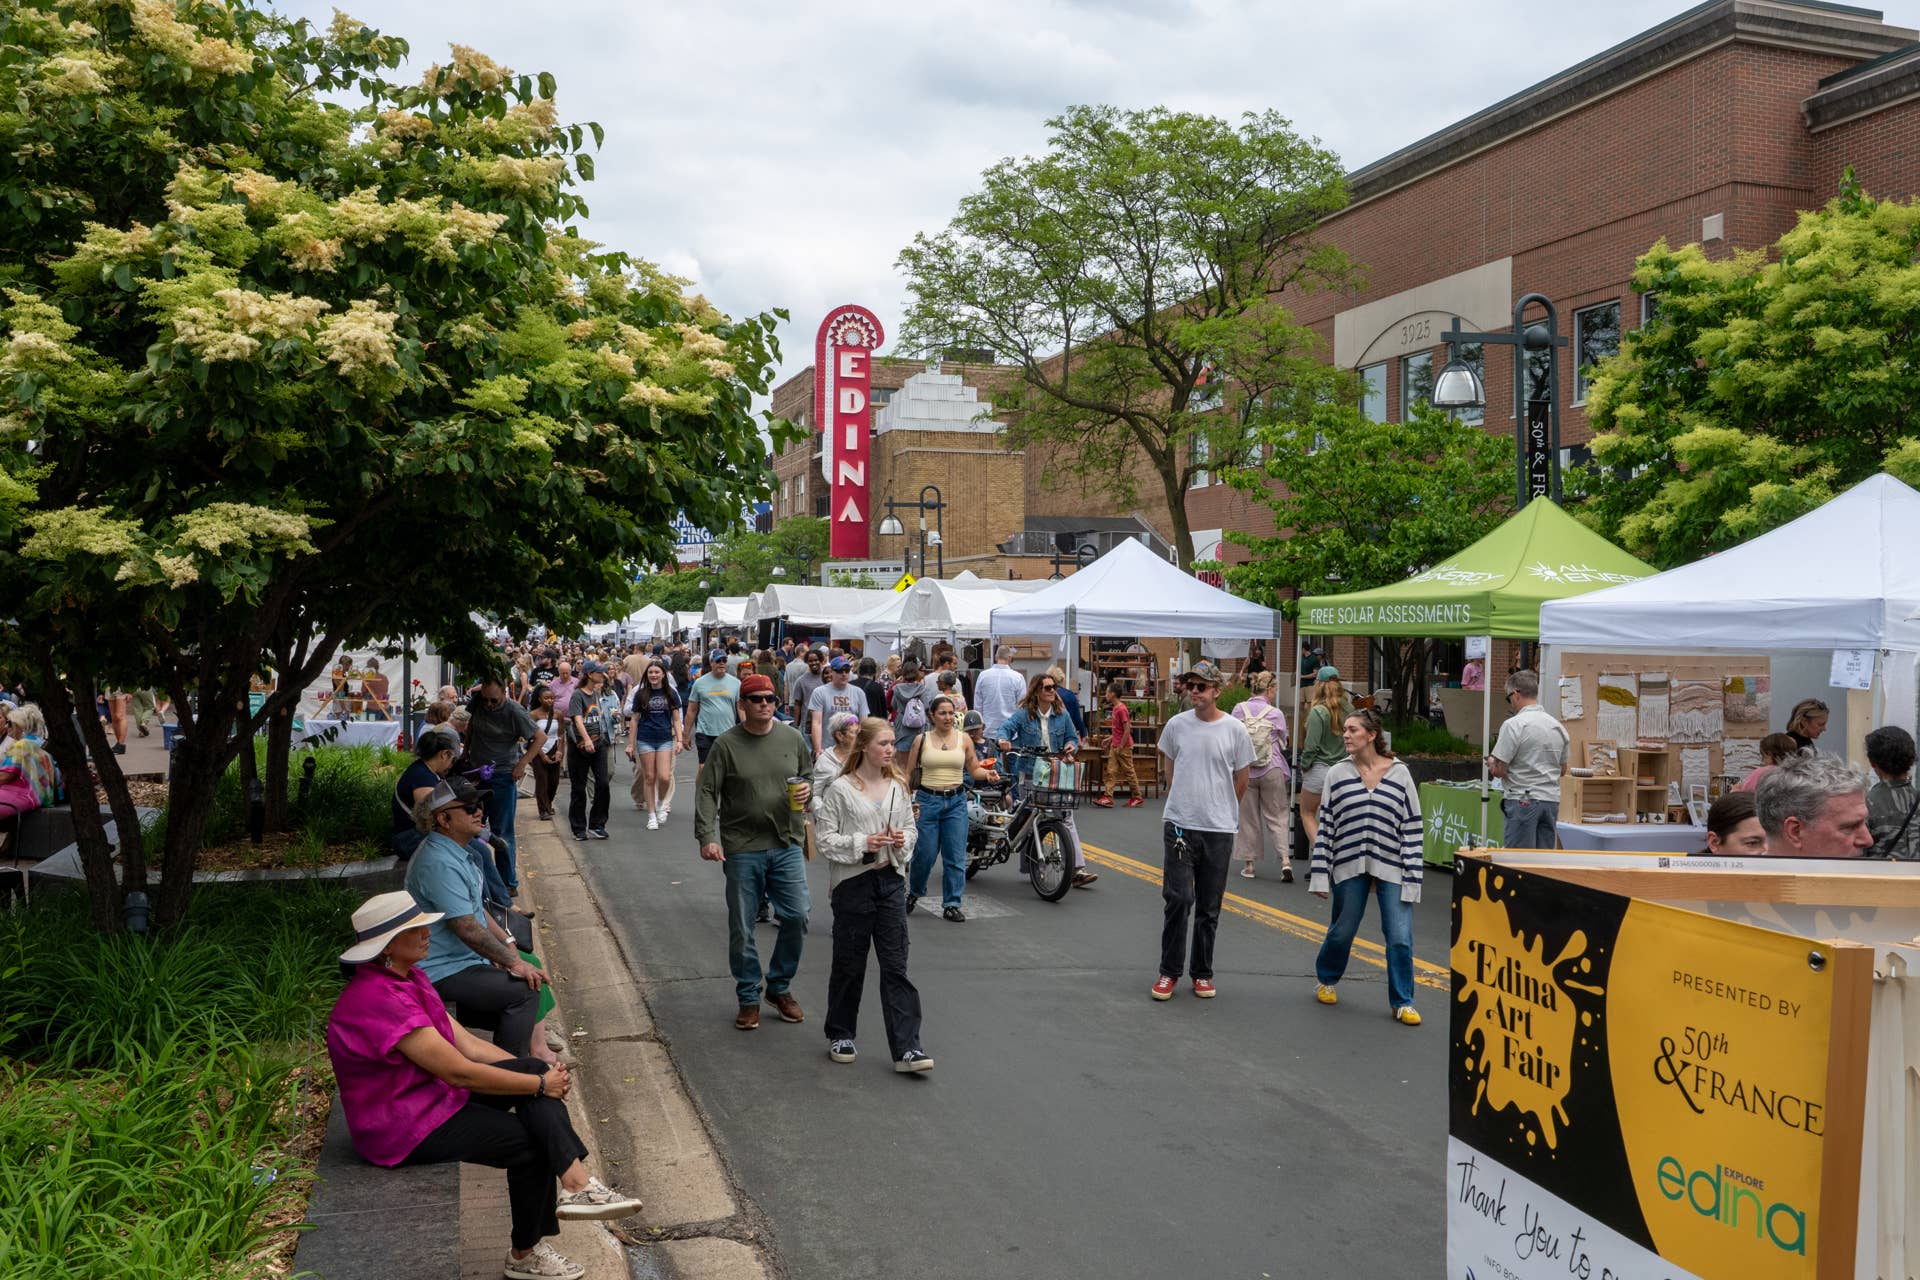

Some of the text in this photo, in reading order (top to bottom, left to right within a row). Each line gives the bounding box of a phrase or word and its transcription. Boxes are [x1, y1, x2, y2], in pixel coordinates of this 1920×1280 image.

[1401, 319, 1431, 345] 3925
[838, 350, 866, 523] EDINA
[1531, 420, 1546, 500] 50th & FR
[1560, 563, 1598, 573] ALL
[1563, 572, 1643, 583] ENER
[1310, 604, 1470, 625] FREE SOLAR ASSESSMENTS
[833, 695, 850, 706] CSC
[1446, 813, 1468, 829] ALL
[1469, 939, 1558, 1012] Edina
[1673, 970, 1801, 1018] PRESENTED BY
[1486, 999, 1533, 1040] Art
[1681, 1026, 1729, 1061] 50th
[1503, 1037, 1560, 1090] Fair
[1653, 1036, 1824, 1137] & FRANCE
[1724, 1167, 1764, 1191] EXPLORE
[1457, 1155, 1592, 1280] Thank You to
[1657, 1155, 1806, 1256] edina
[1483, 1255, 1502, 1274] INFO
